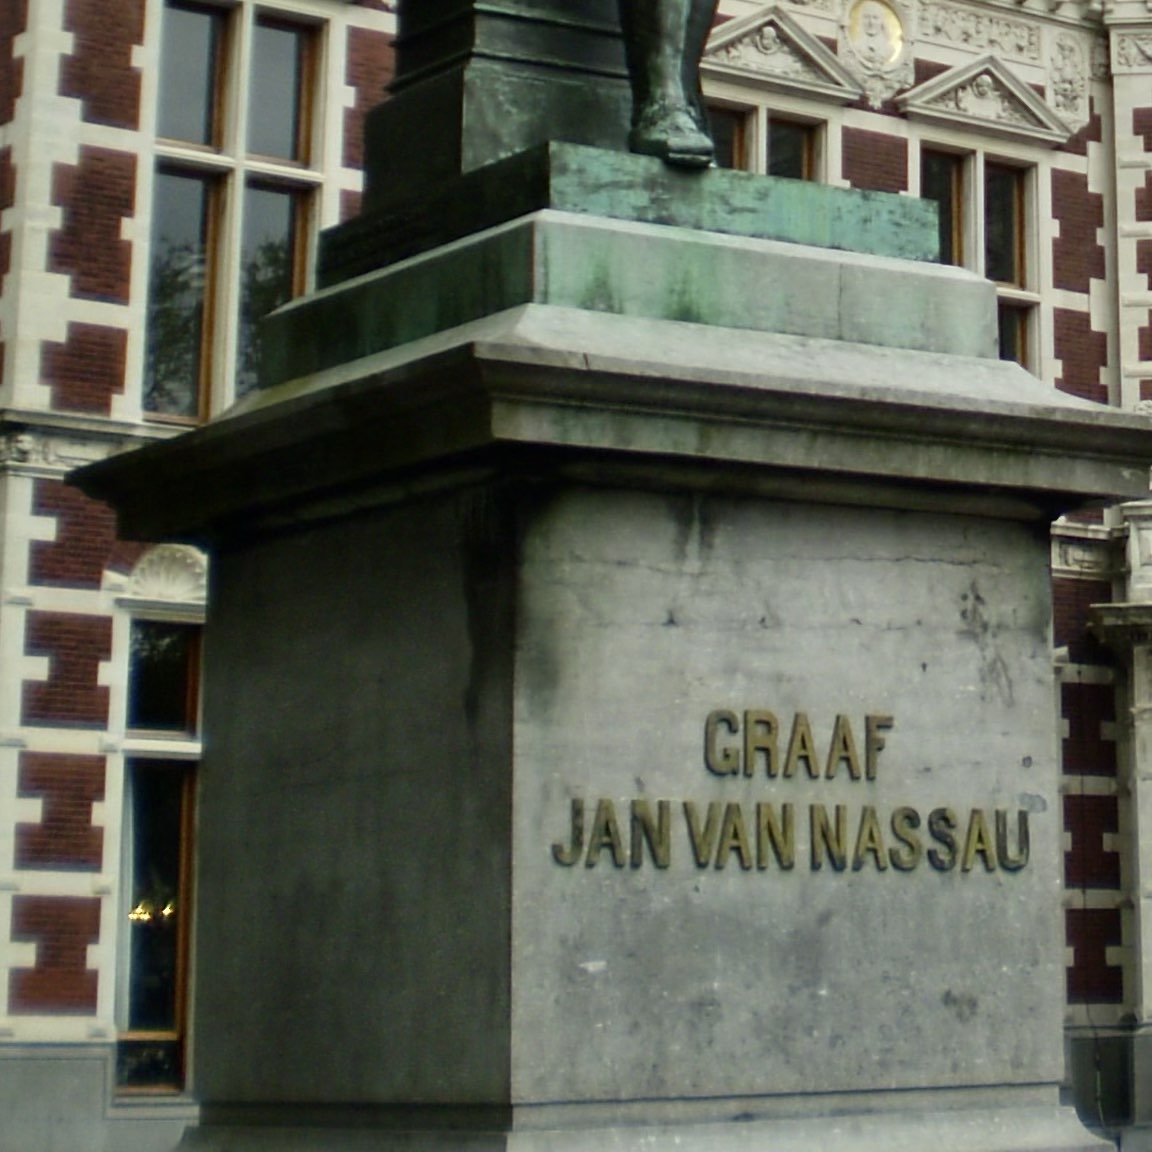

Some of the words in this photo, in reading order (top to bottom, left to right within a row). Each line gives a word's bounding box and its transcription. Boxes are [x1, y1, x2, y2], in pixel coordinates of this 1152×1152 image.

[704, 709, 894, 781] GRAAF
[552, 798, 671, 870] JAN
[683, 801, 795, 871] VAN
[810, 804, 1031, 874] NASSAU
